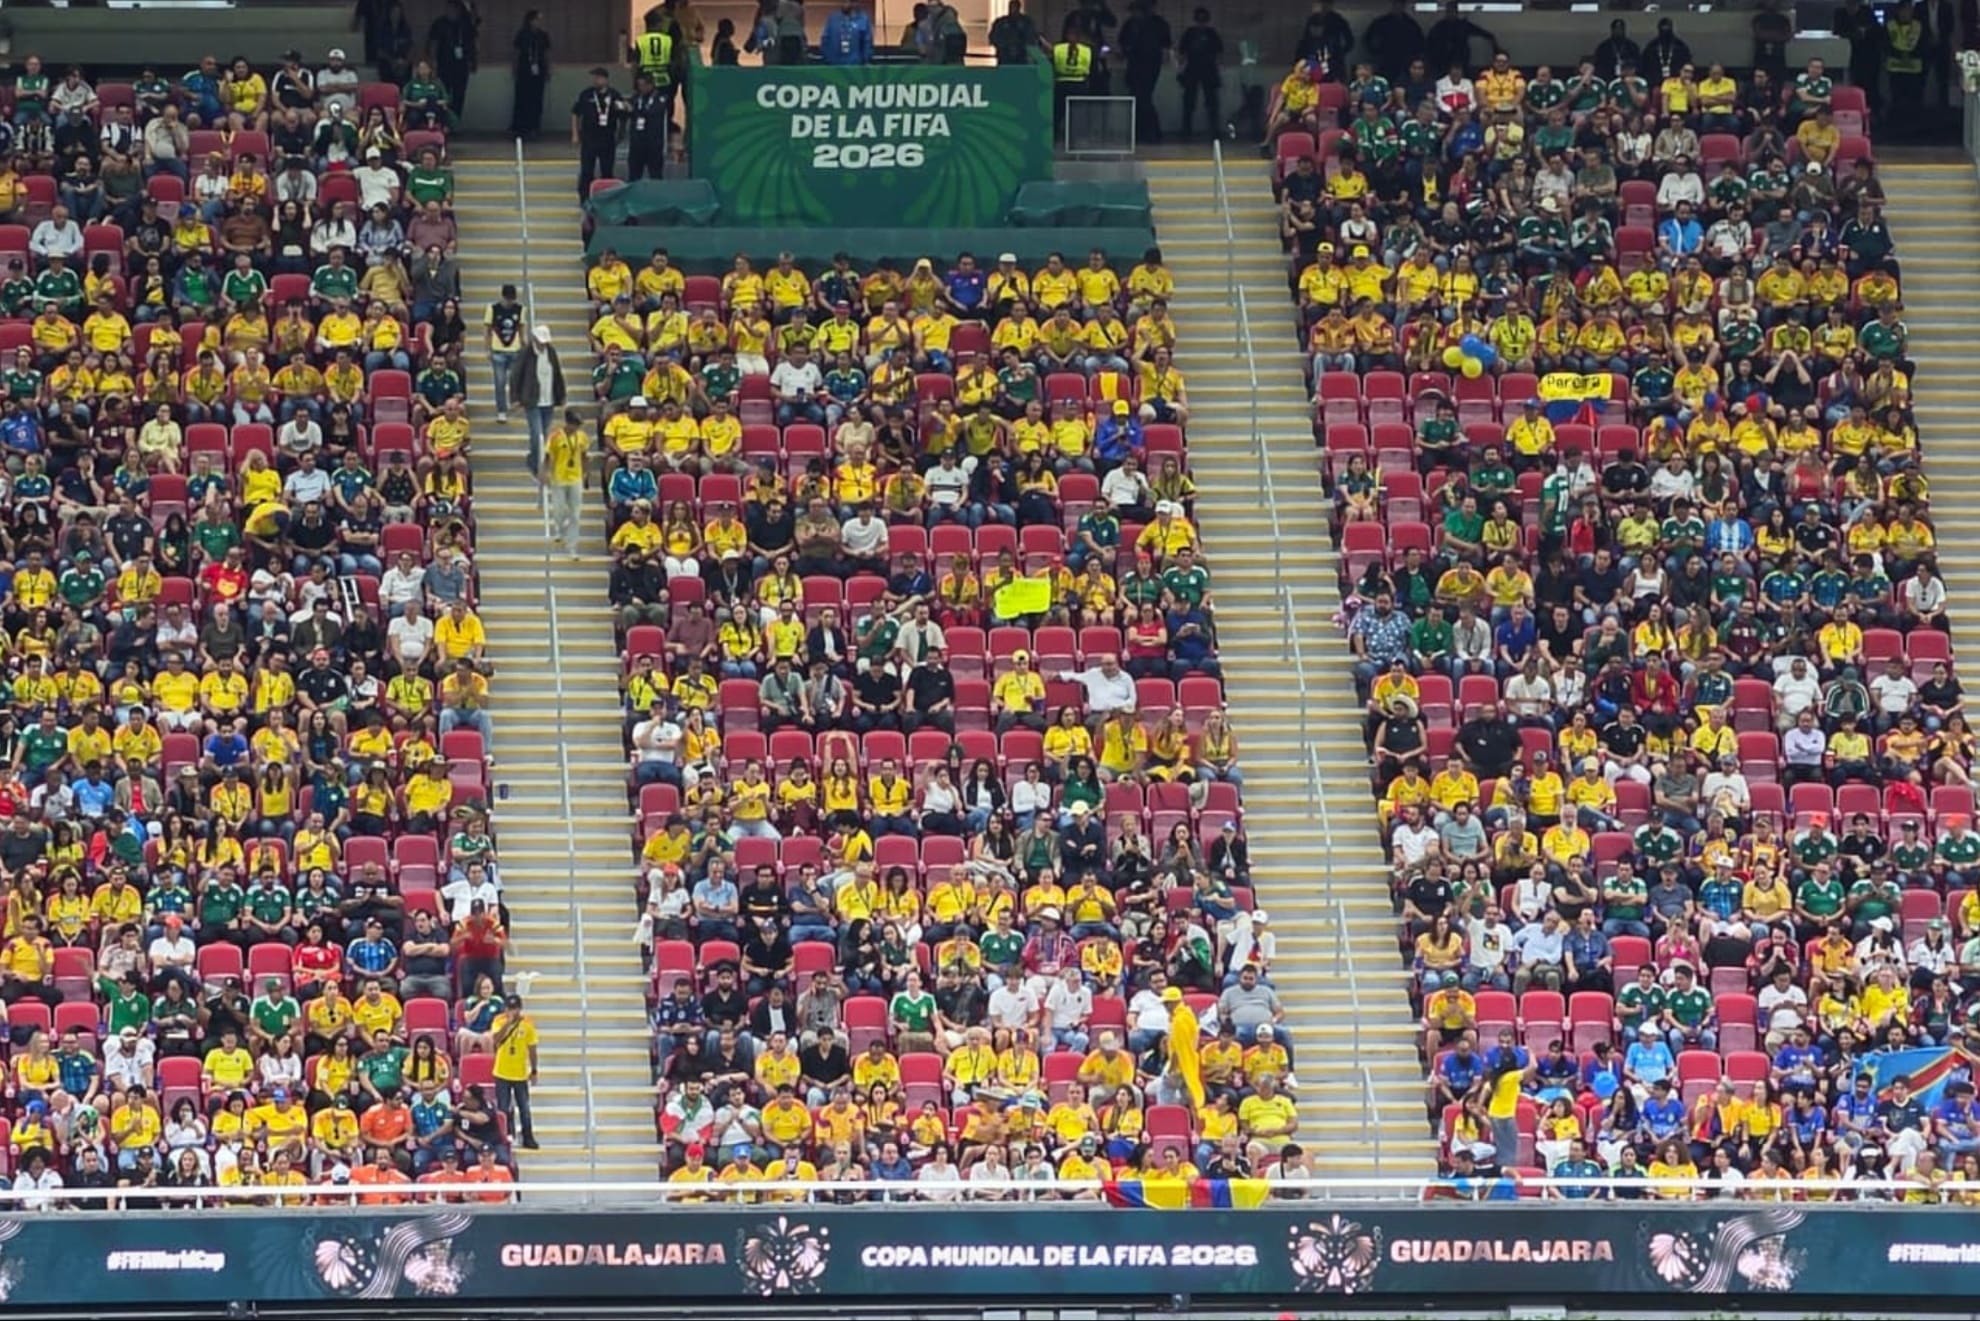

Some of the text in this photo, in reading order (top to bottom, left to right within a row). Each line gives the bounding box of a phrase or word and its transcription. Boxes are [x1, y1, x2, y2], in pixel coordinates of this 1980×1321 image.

[757, 84, 989, 109] COPA MUNDIAL
[791, 113, 950, 138] DE LA FIFA
[813, 143, 924, 169] 2026
[500, 1243, 726, 1267] GUADALAJARA
[860, 1244, 1259, 1267] COPA MUNDIAL DE LA FIFA 2026
[1390, 1239, 1614, 1264] GUADALAJARA
